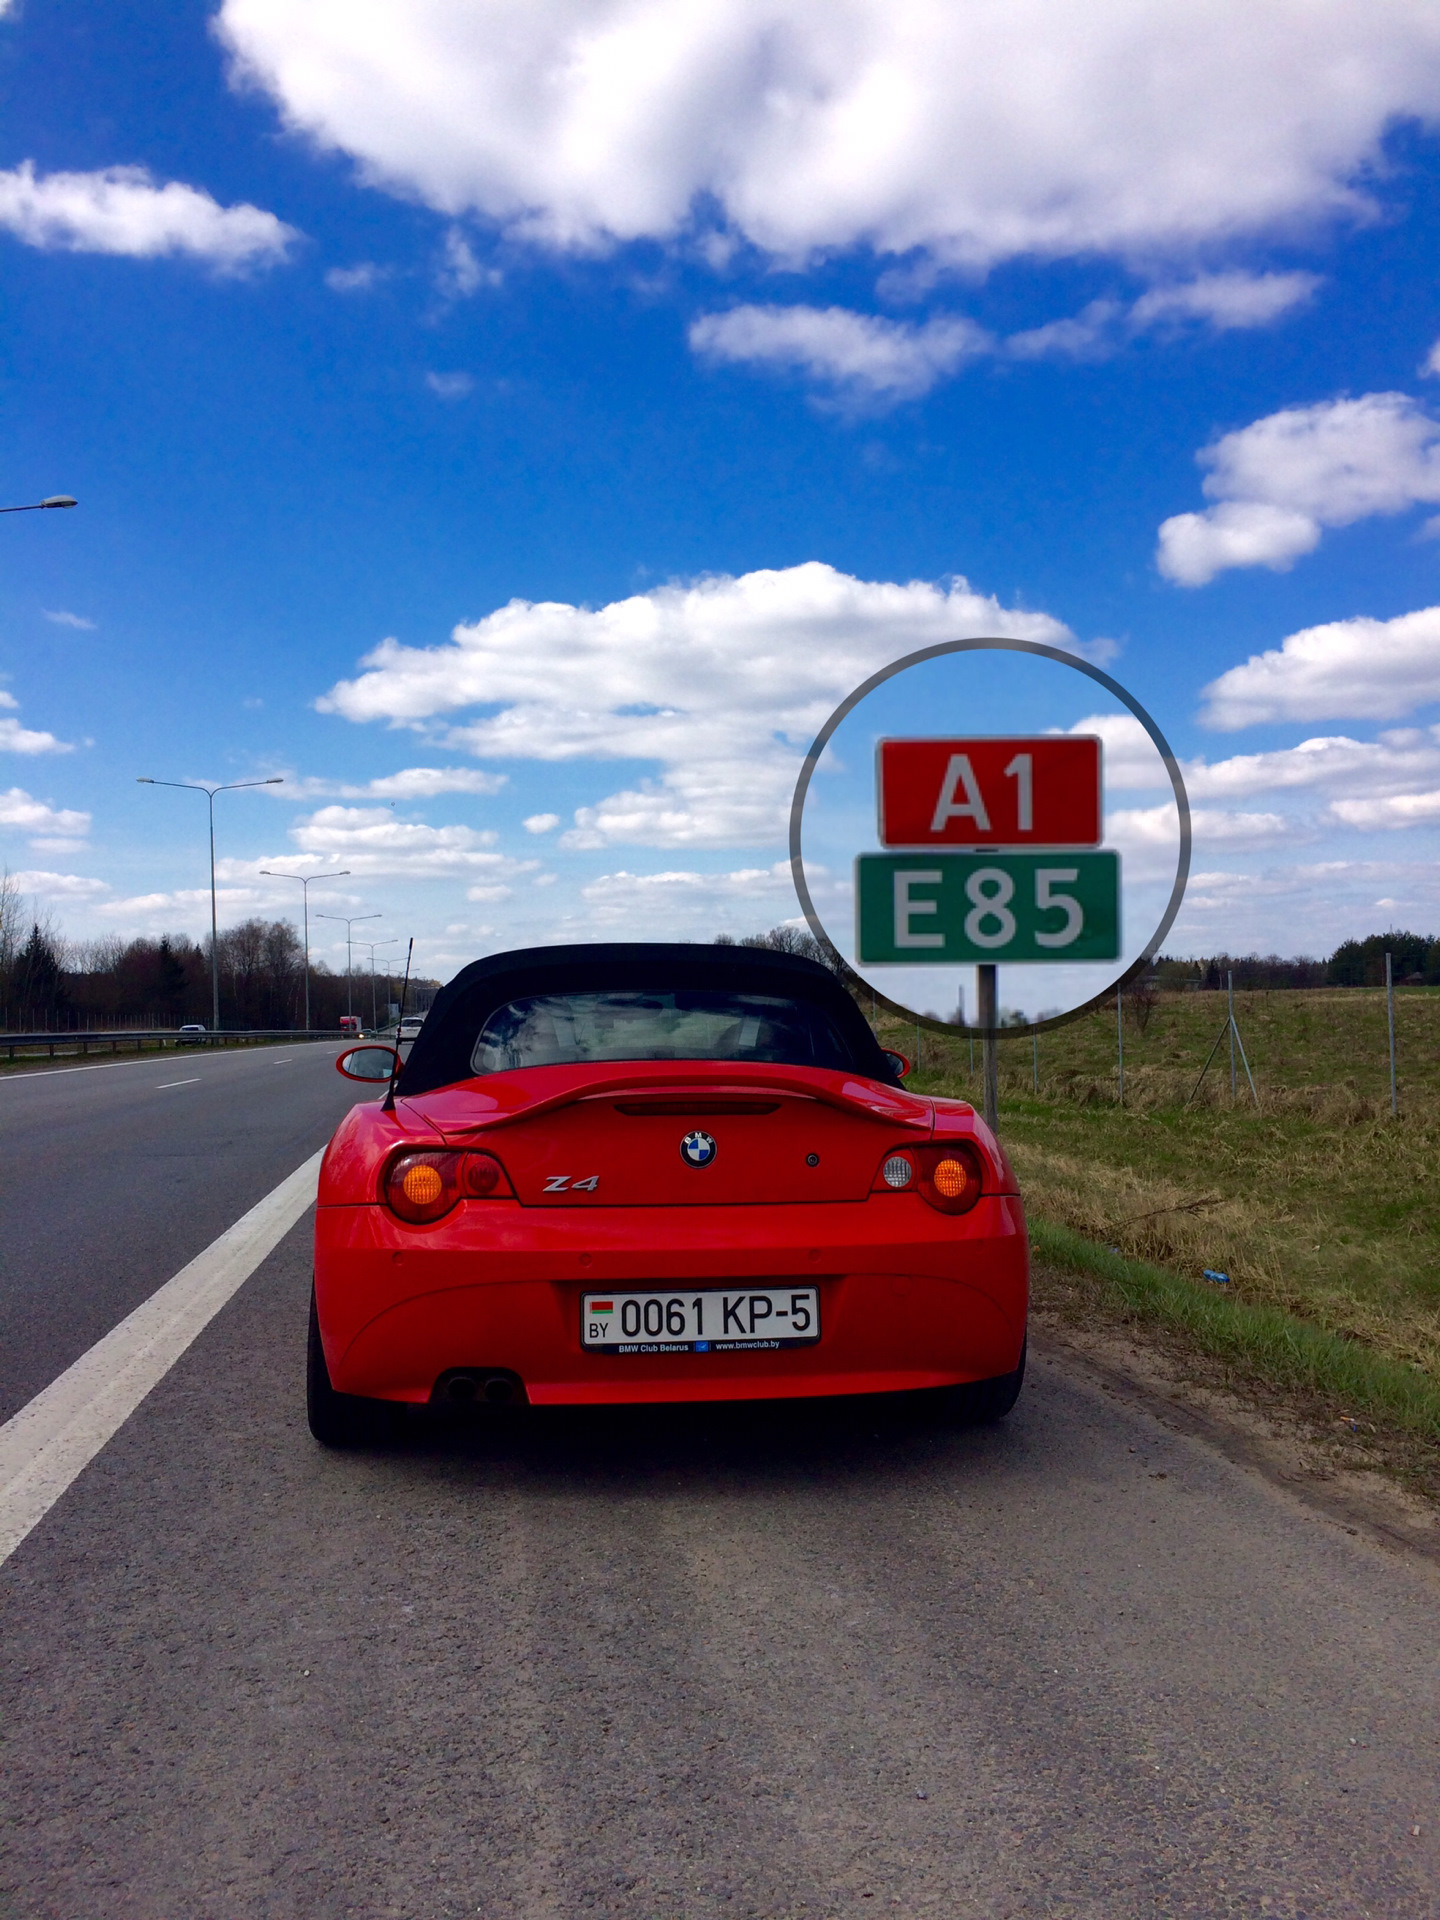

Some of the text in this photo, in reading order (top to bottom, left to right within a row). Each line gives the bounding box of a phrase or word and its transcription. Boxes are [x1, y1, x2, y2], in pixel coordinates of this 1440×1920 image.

[930, 753, 1034, 831] A1
[684, 1131, 714, 1145] BMW
[542, 1175, 600, 1192] Z4
[621, 1294, 811, 1337] 0061 KP-5
[589, 1322, 609, 1338] BY
[618, 1343, 689, 1353] BMW Club Belarus
[715, 1340, 780, 1350] www.bmwclub.by
